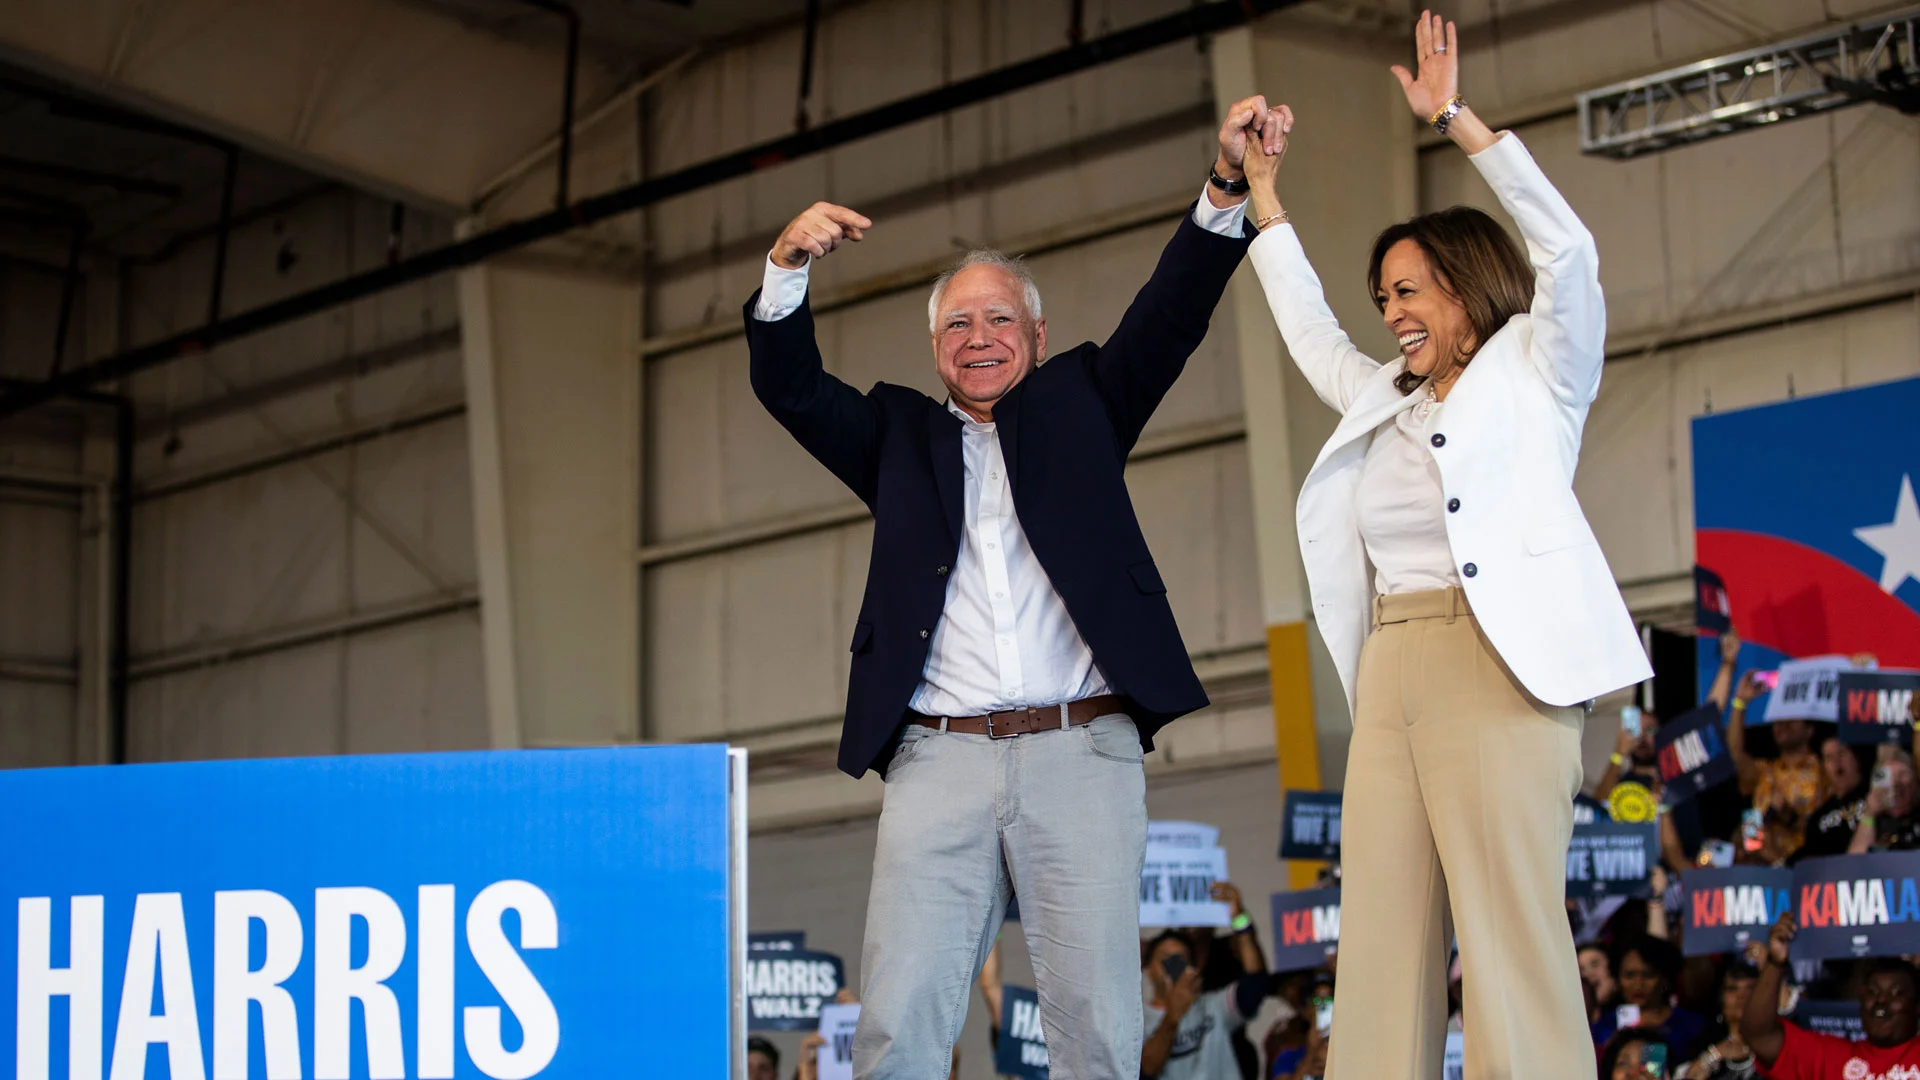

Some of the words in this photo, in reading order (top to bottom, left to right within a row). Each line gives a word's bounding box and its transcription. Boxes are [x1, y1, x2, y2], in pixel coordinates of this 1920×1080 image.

[1592, 849, 1646, 880] WIN
[1801, 878, 1920, 928] KAMALA
[16, 878, 560, 1080] HARRIS
[751, 997, 821, 1018] WALZ
